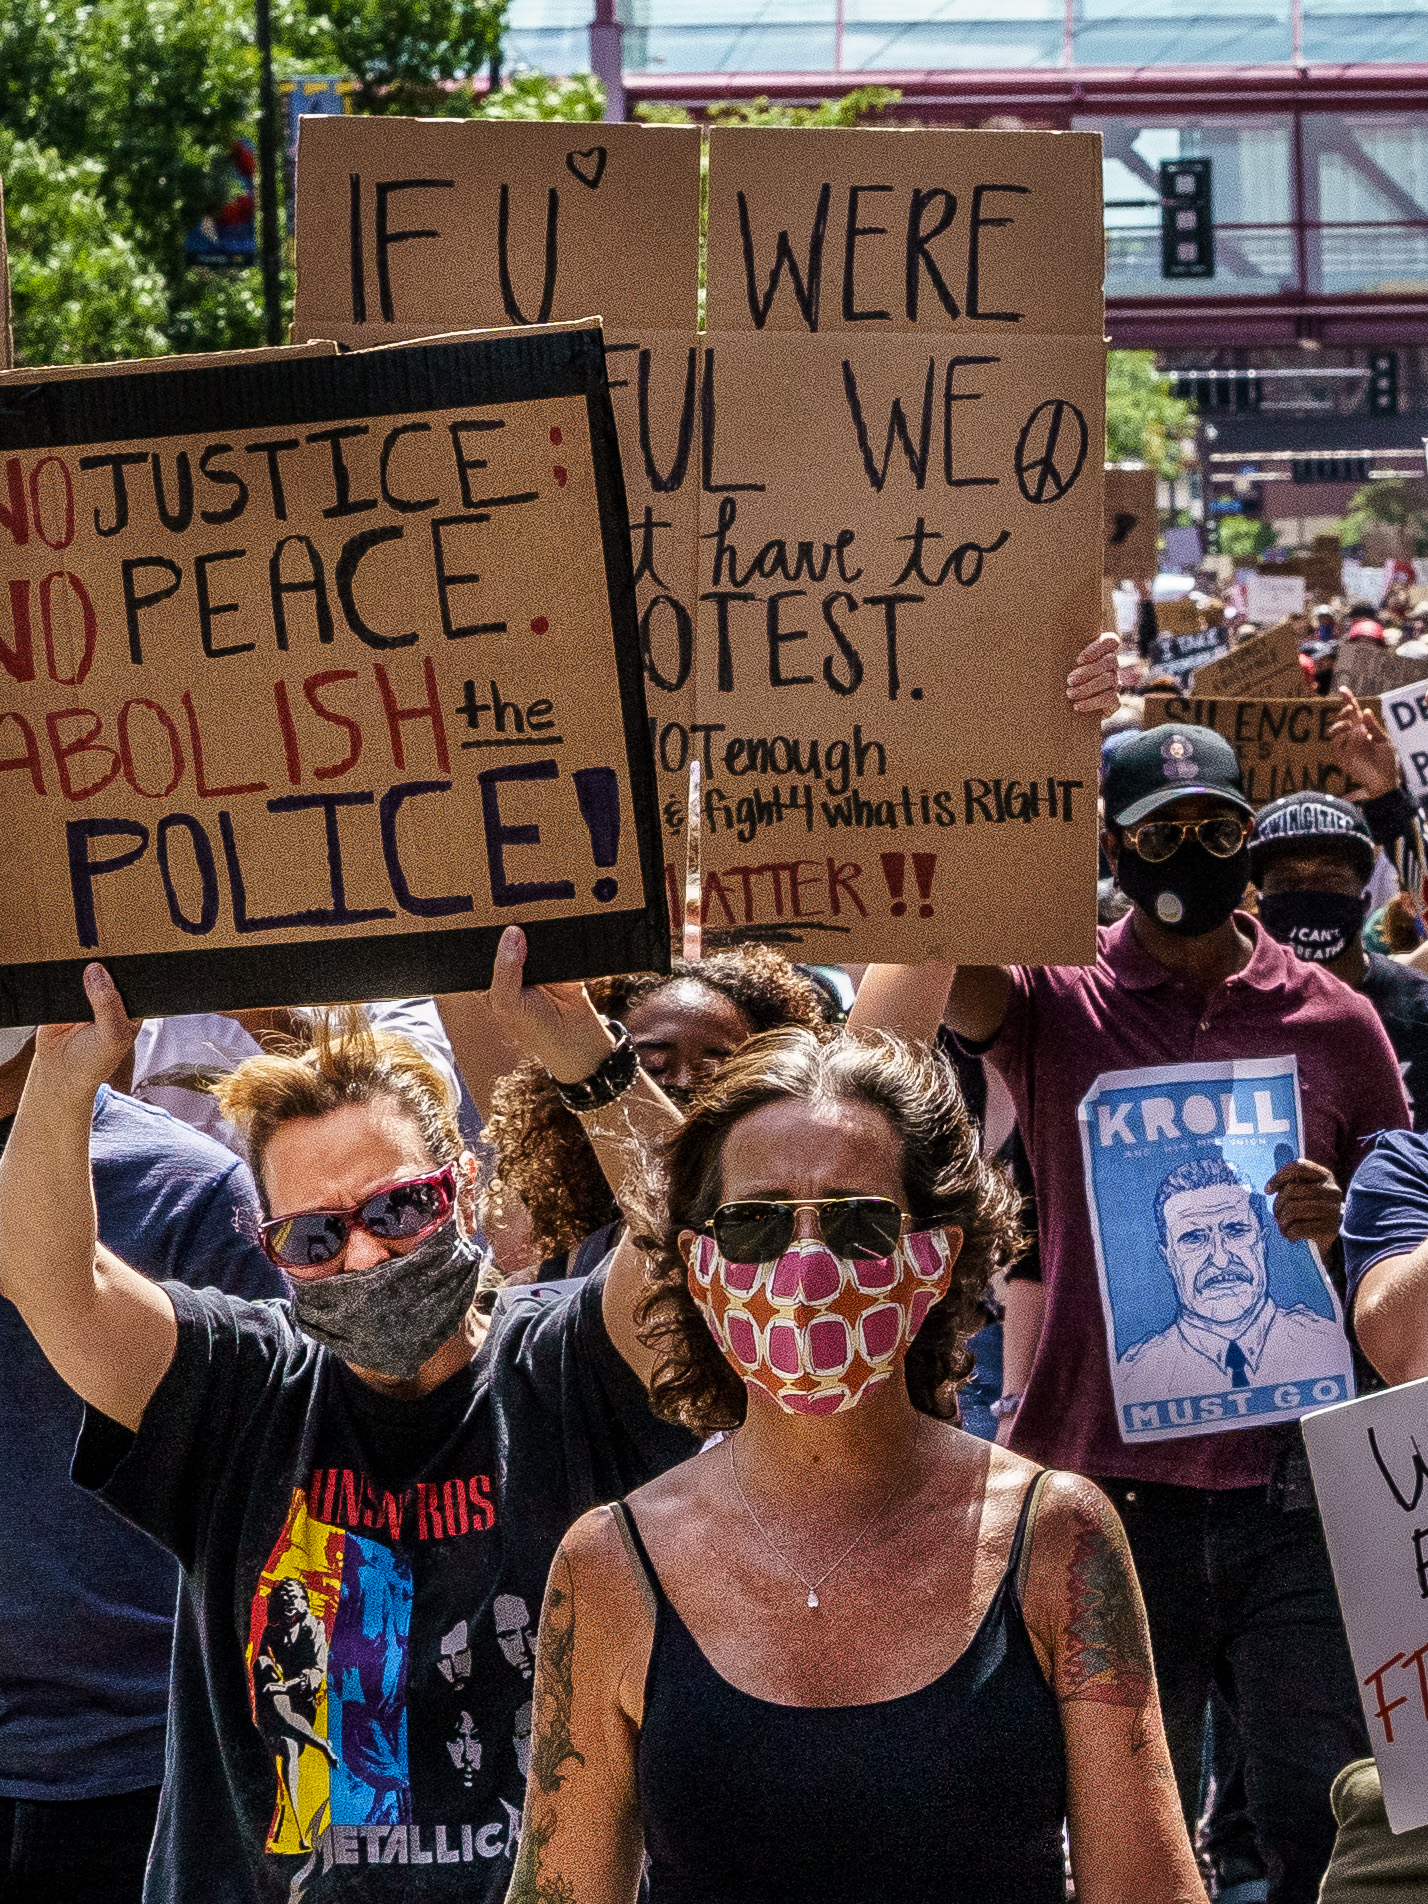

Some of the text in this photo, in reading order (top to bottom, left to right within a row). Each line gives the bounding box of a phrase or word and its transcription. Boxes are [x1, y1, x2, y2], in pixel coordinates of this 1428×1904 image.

[349, 172, 1032, 332] IF U WERE
[842, 354, 1002, 492] WE
[700, 496, 863, 588] have
[891, 516, 1012, 587] to
[455, 680, 556, 735] the
[648, 717, 887, 796] OT enough
[963, 776, 1084, 825] RIGHT
[66, 759, 621, 950] POLICE!
[1099, 1089, 1291, 1148] KROLL
[1130, 1378, 1342, 1431] MUST GO
